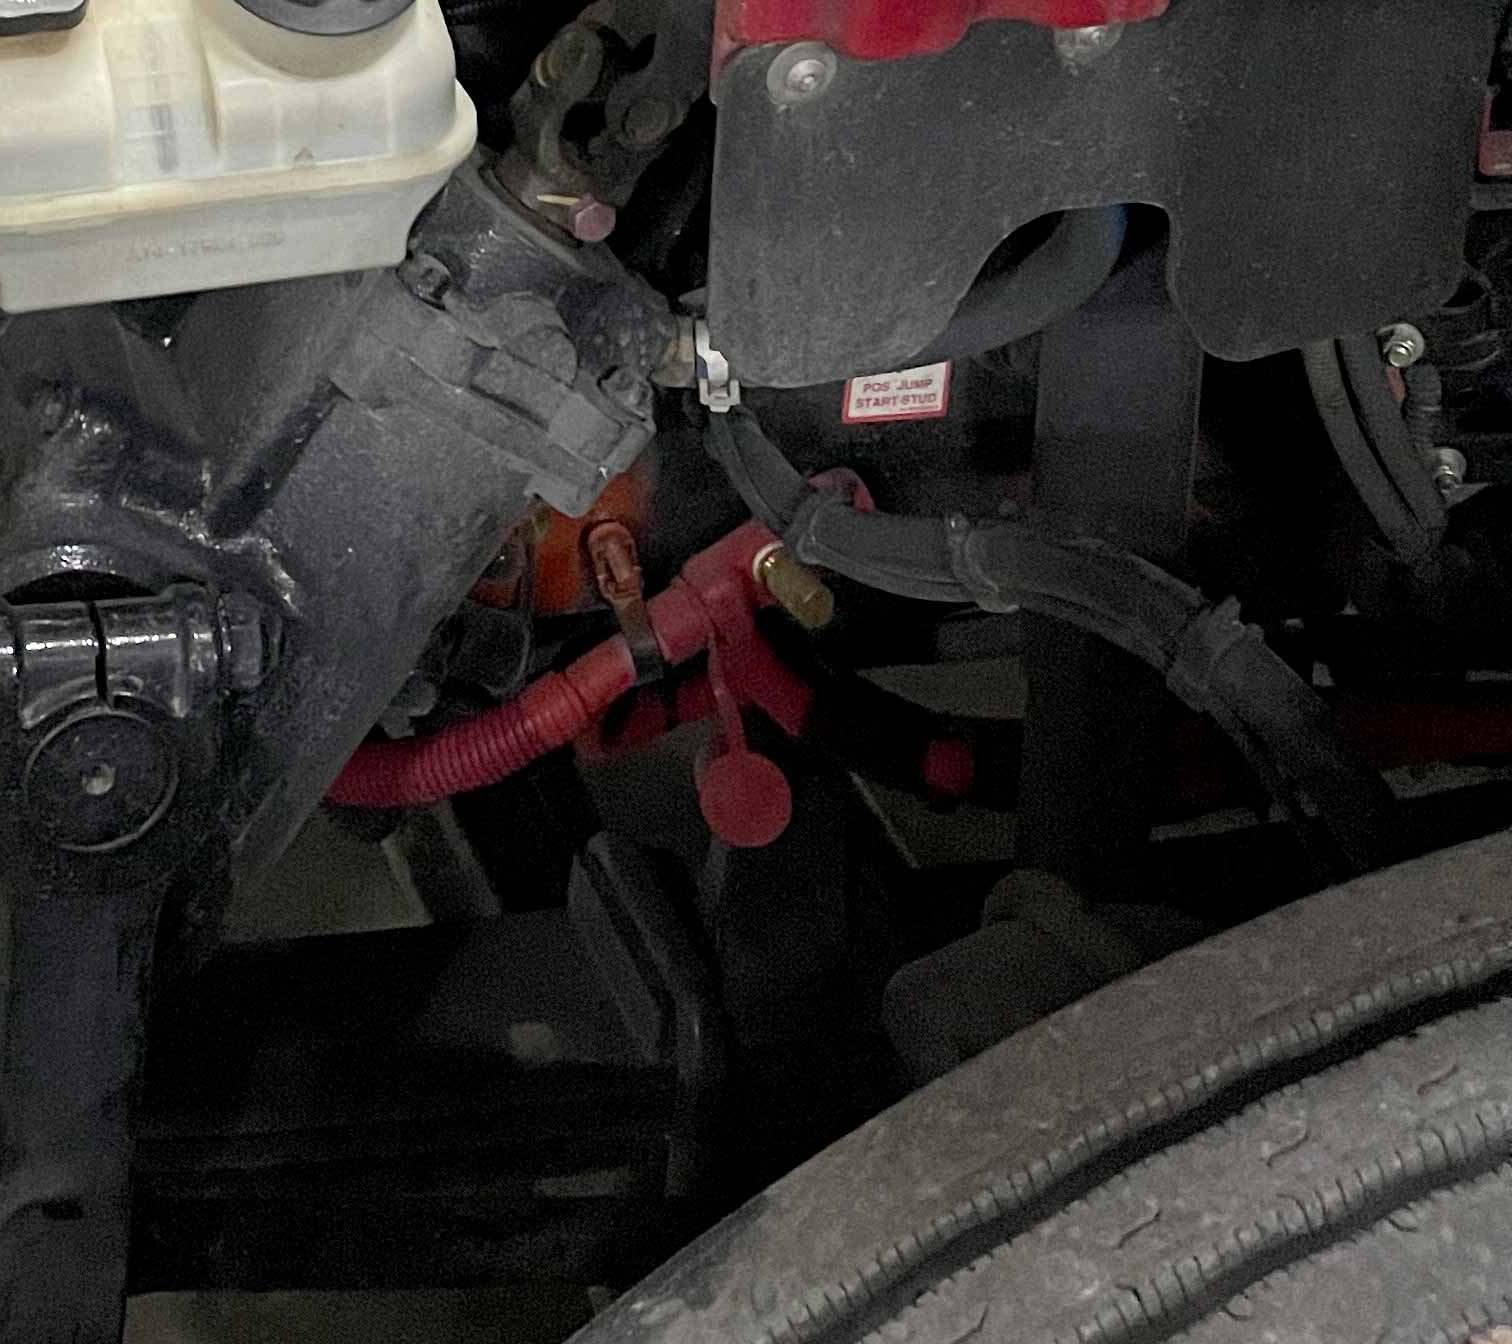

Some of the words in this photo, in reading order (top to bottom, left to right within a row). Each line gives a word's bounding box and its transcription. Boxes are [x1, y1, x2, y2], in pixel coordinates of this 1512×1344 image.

[896, 378, 934, 391] JUMP
[855, 395, 898, 409] START
[901, 393, 937, 406] STUD
